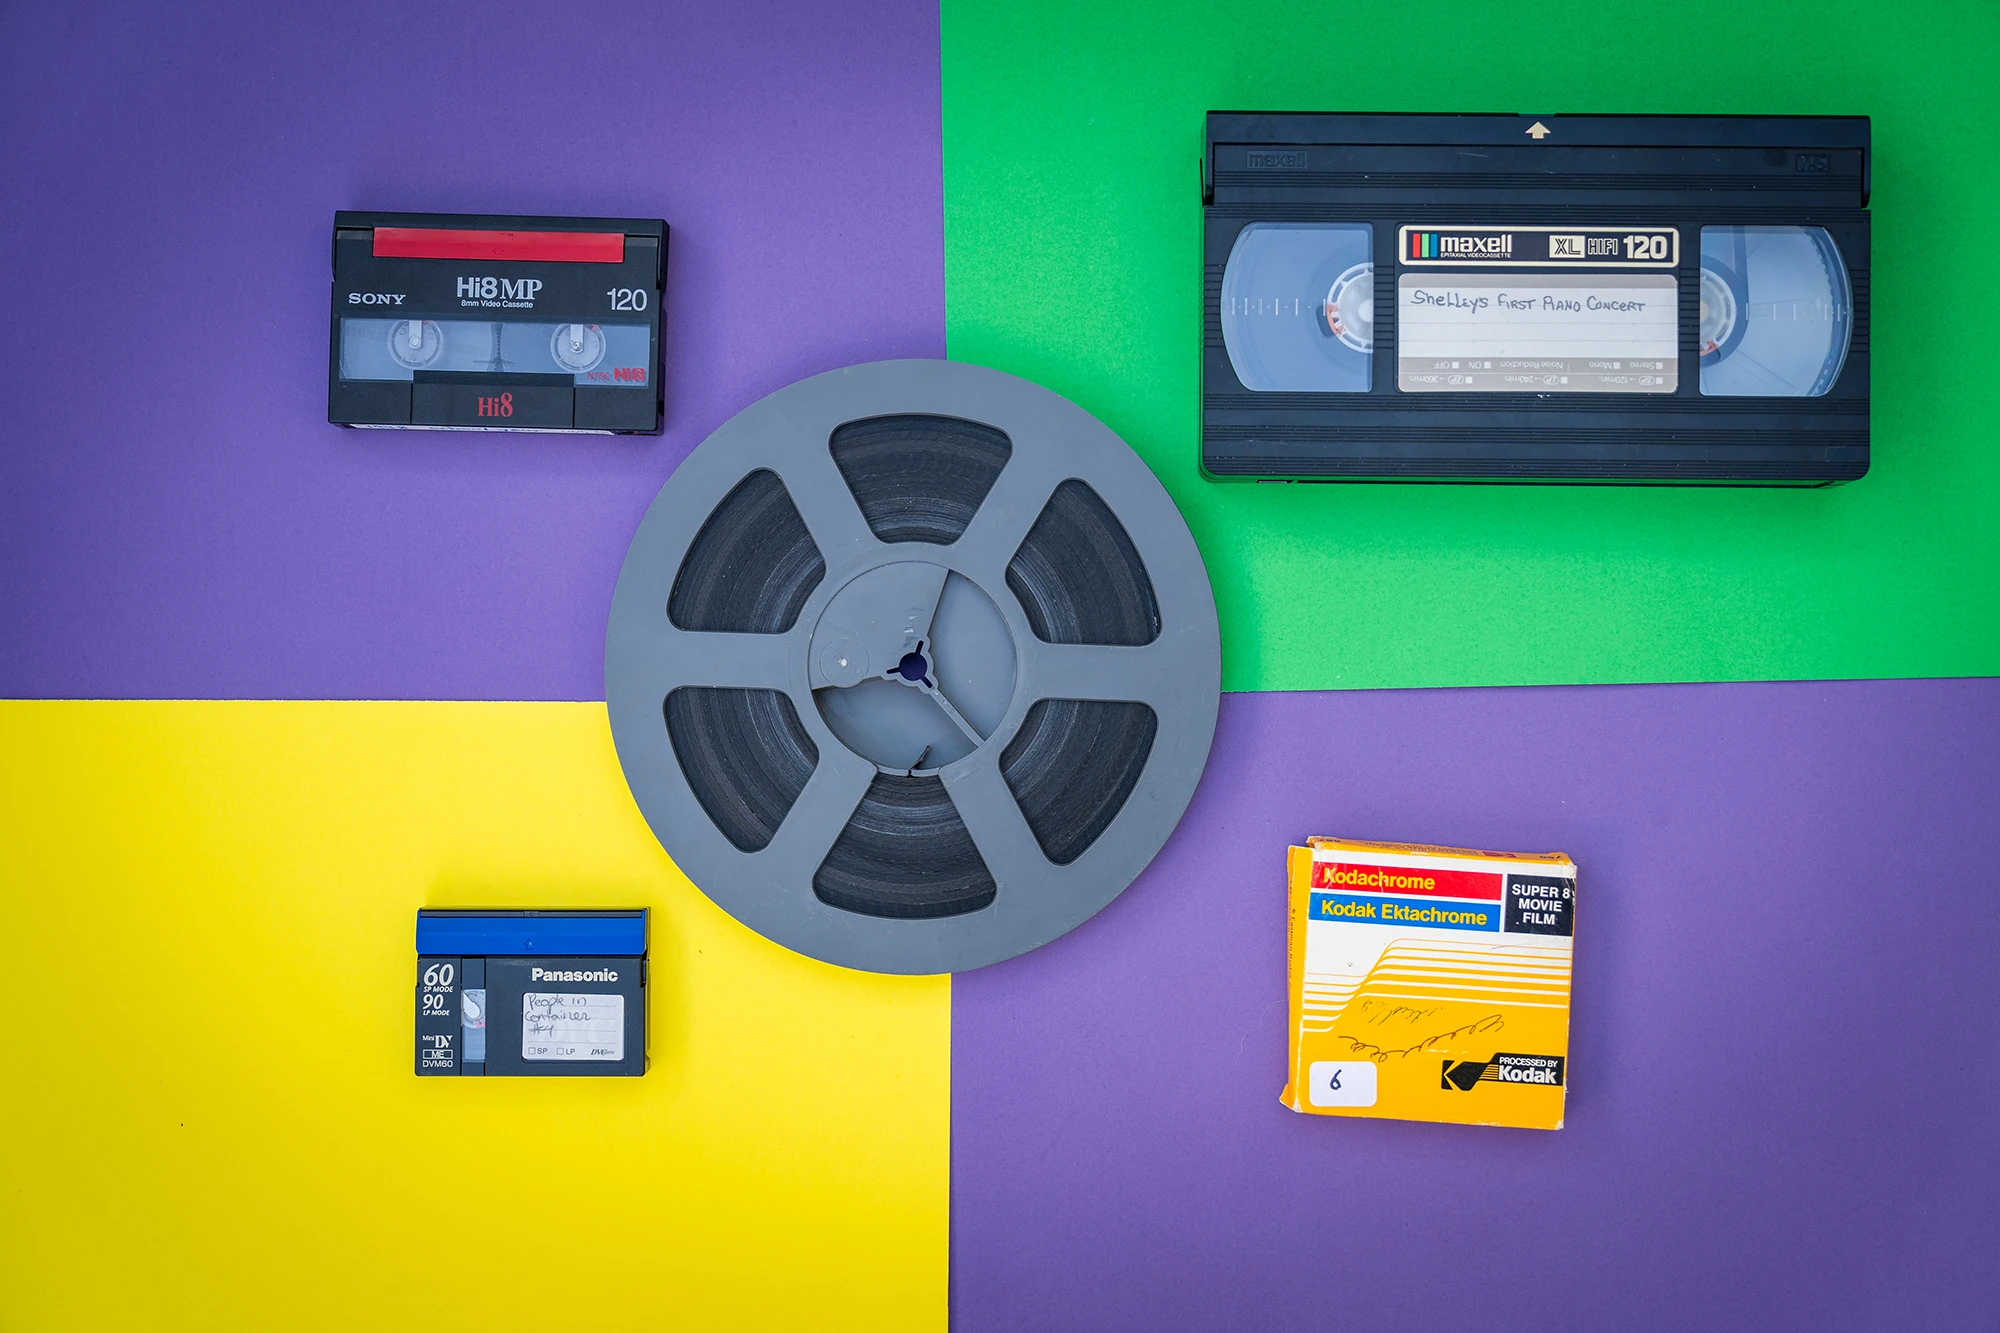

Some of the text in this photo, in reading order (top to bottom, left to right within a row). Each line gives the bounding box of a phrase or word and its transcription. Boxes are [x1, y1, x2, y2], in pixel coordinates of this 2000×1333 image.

[1248, 151, 1306, 168] maxell
[1440, 234, 1512, 253] maxell
[1554, 235, 1667, 259] XL HIFI 120
[348, 292, 406, 305] SONY
[481, 300, 501, 308] Video
[606, 288, 647, 311] 120
[1434, 361, 1655, 370] Stereo Mono Noise Reduction ON OFF
[478, 392, 513, 417] Hi8
[1323, 867, 1436, 890] Kodachrome
[1511, 884, 1571, 899] SUPER 8
[1321, 900, 1488, 925] Kodak Ektachrome
[1518, 898, 1563, 912] MOVIE
[1522, 912, 1555, 925] FILM
[423, 963, 454, 987] 60
[531, 967, 619, 982] Panasonic
[422, 994, 444, 1010] 90
[528, 993, 565, 1014] People
[431, 1051, 445, 1059] ME
[1499, 1056, 1558, 1068] PROCESSED BY
[423, 1060, 453, 1068] DVM60
[1329, 1068, 1342, 1091] 6
[1498, 1065, 1557, 1084] Kodak
